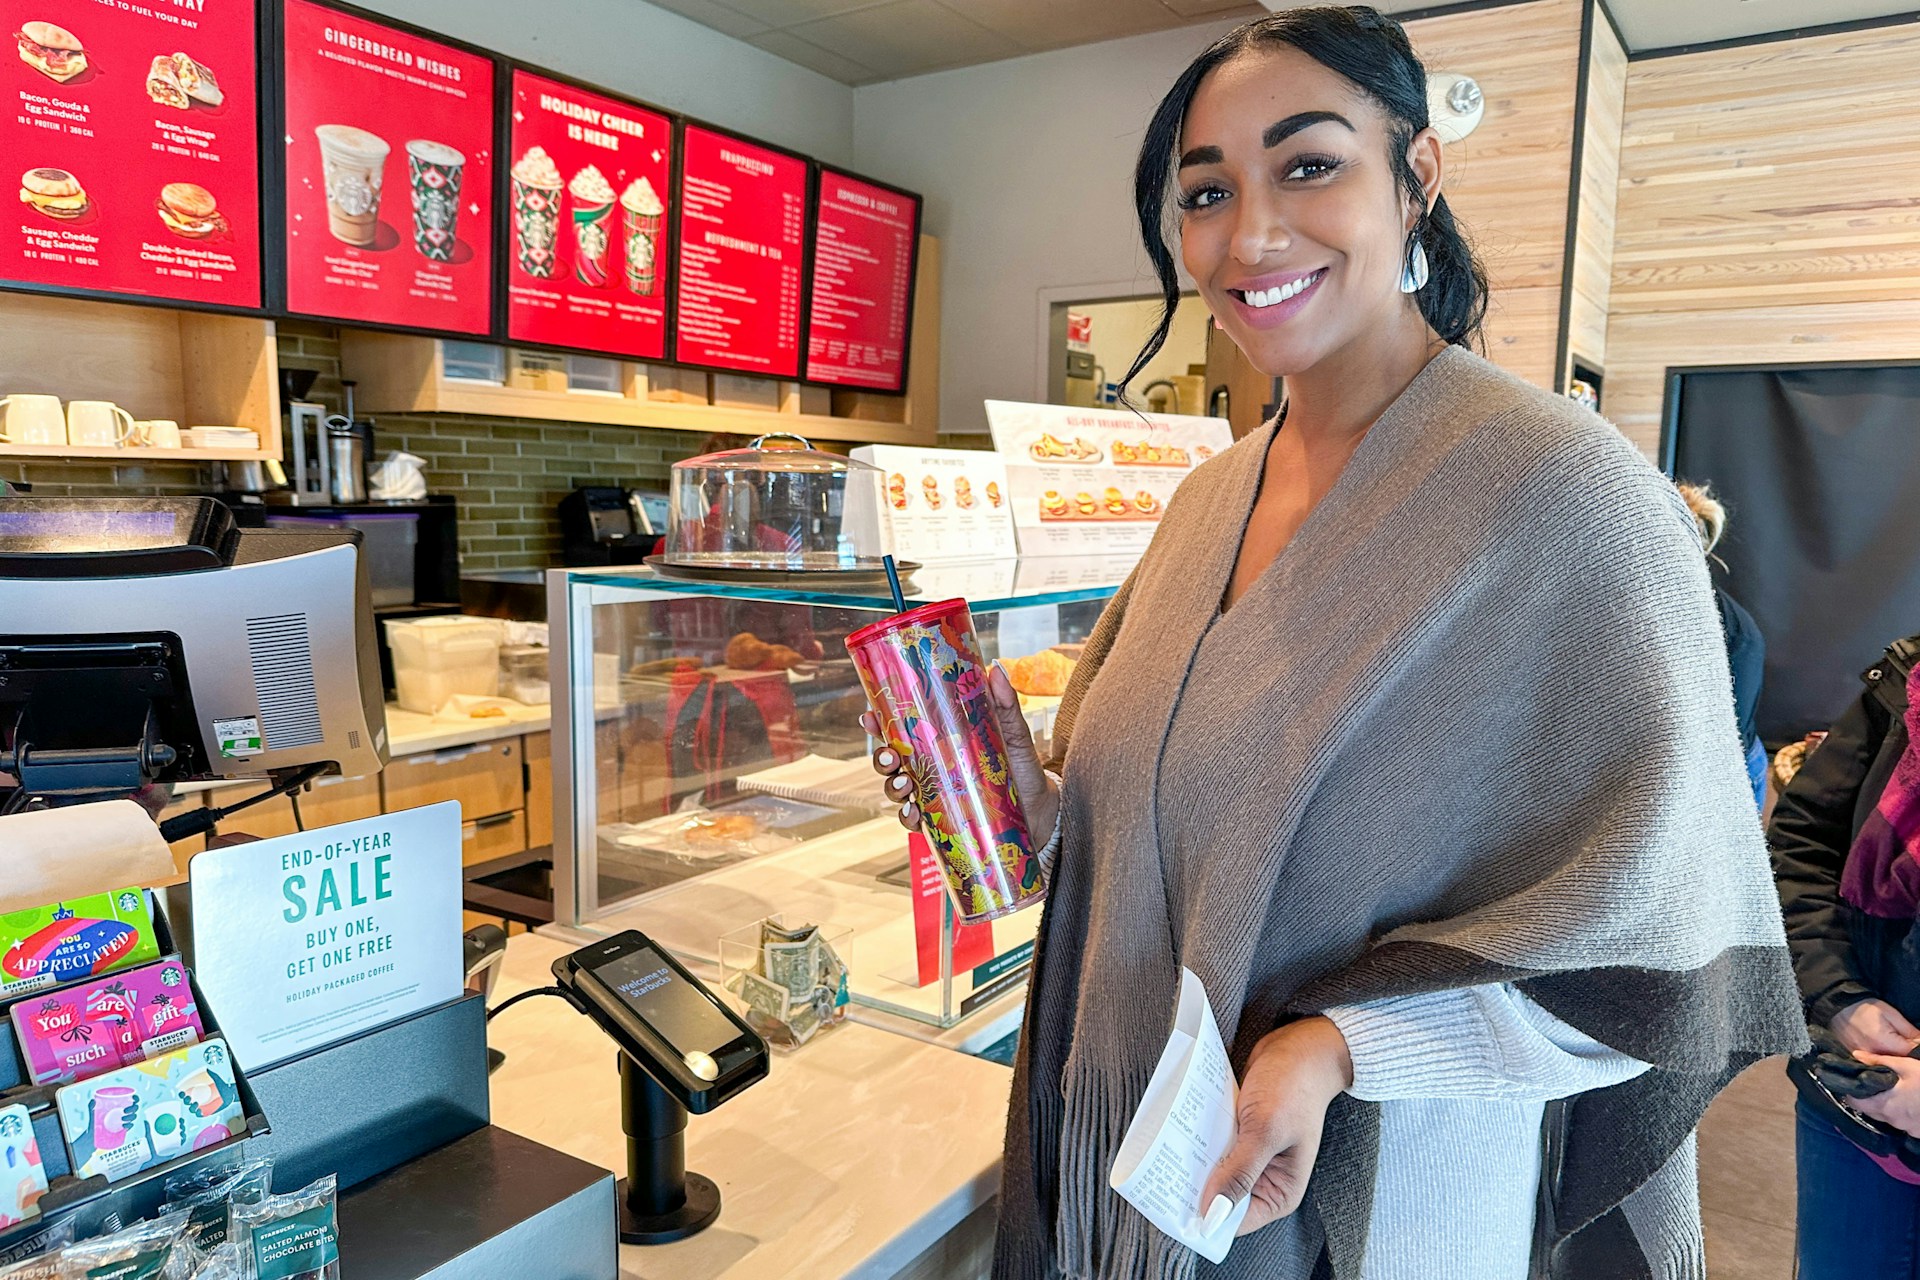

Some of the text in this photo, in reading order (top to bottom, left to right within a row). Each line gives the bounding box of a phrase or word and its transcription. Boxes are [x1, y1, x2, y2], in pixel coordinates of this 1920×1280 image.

[117, 1, 129, 10] TO
[131, 5, 153, 17] FUEL
[155, 11, 179, 24] YOUR
[180, 18, 198, 29] DAY
[324, 27, 461, 82] GINGERBREAD WISHES
[20, 91, 90, 113] Bacon, Gouda &
[25, 102, 86, 122] Egg Sandwich
[540, 93, 645, 138] HOLIDAY CHEER
[35, 119, 60, 130] PROTEIN
[83, 129, 94, 137] CAL
[155, 119, 216, 140] Bacon, Sausage
[568, 123, 619, 151] IS HERE
[171, 132, 186, 144] Egg
[186, 135, 209, 148] Wrap
[21, 225, 99, 243] Sausage, Cheddar
[27, 236, 96, 252] & Egg Sandwich
[40, 252, 66, 262] PROTEIN
[140, 251, 175, 263] Cheddar
[184, 257, 198, 268] Egg
[199, 259, 237, 271] Sandwich
[282, 831, 392, 871] END-OF-YEAR
[282, 853, 393, 924] SALE
[59, 934, 81, 945] YOU
[306, 916, 380, 949] BUY ONE,
[12, 931, 130, 973] APPRECIATED
[55, 941, 91, 957] ARE SO
[287, 934, 393, 979] GET ONE FREE
[3, 975, 46, 991] STARBUCKS
[286, 963, 395, 1004] HOLIDAY PACKAGED COFFEE
[617, 967, 669, 993] Welcome to
[630, 975, 672, 998] Starbucks
[37, 1000, 125, 1032] You are
[152, 1004, 182, 1027] gift
[66, 1031, 133, 1068] such a
[150, 1030, 188, 1046] STARBUCKS
[157, 1037, 184, 1048] REWARDS
[1170, 1111, 1207, 1148] Change Due
[100, 1140, 141, 1160] STARBUCKS
[201, 1230, 224, 1246] ALTED
[260, 1224, 295, 1240] STARBUCKS
[262, 1225, 328, 1253] SALTED ALMOND
[263, 1234, 334, 1263] CHOCOLATE BITES
